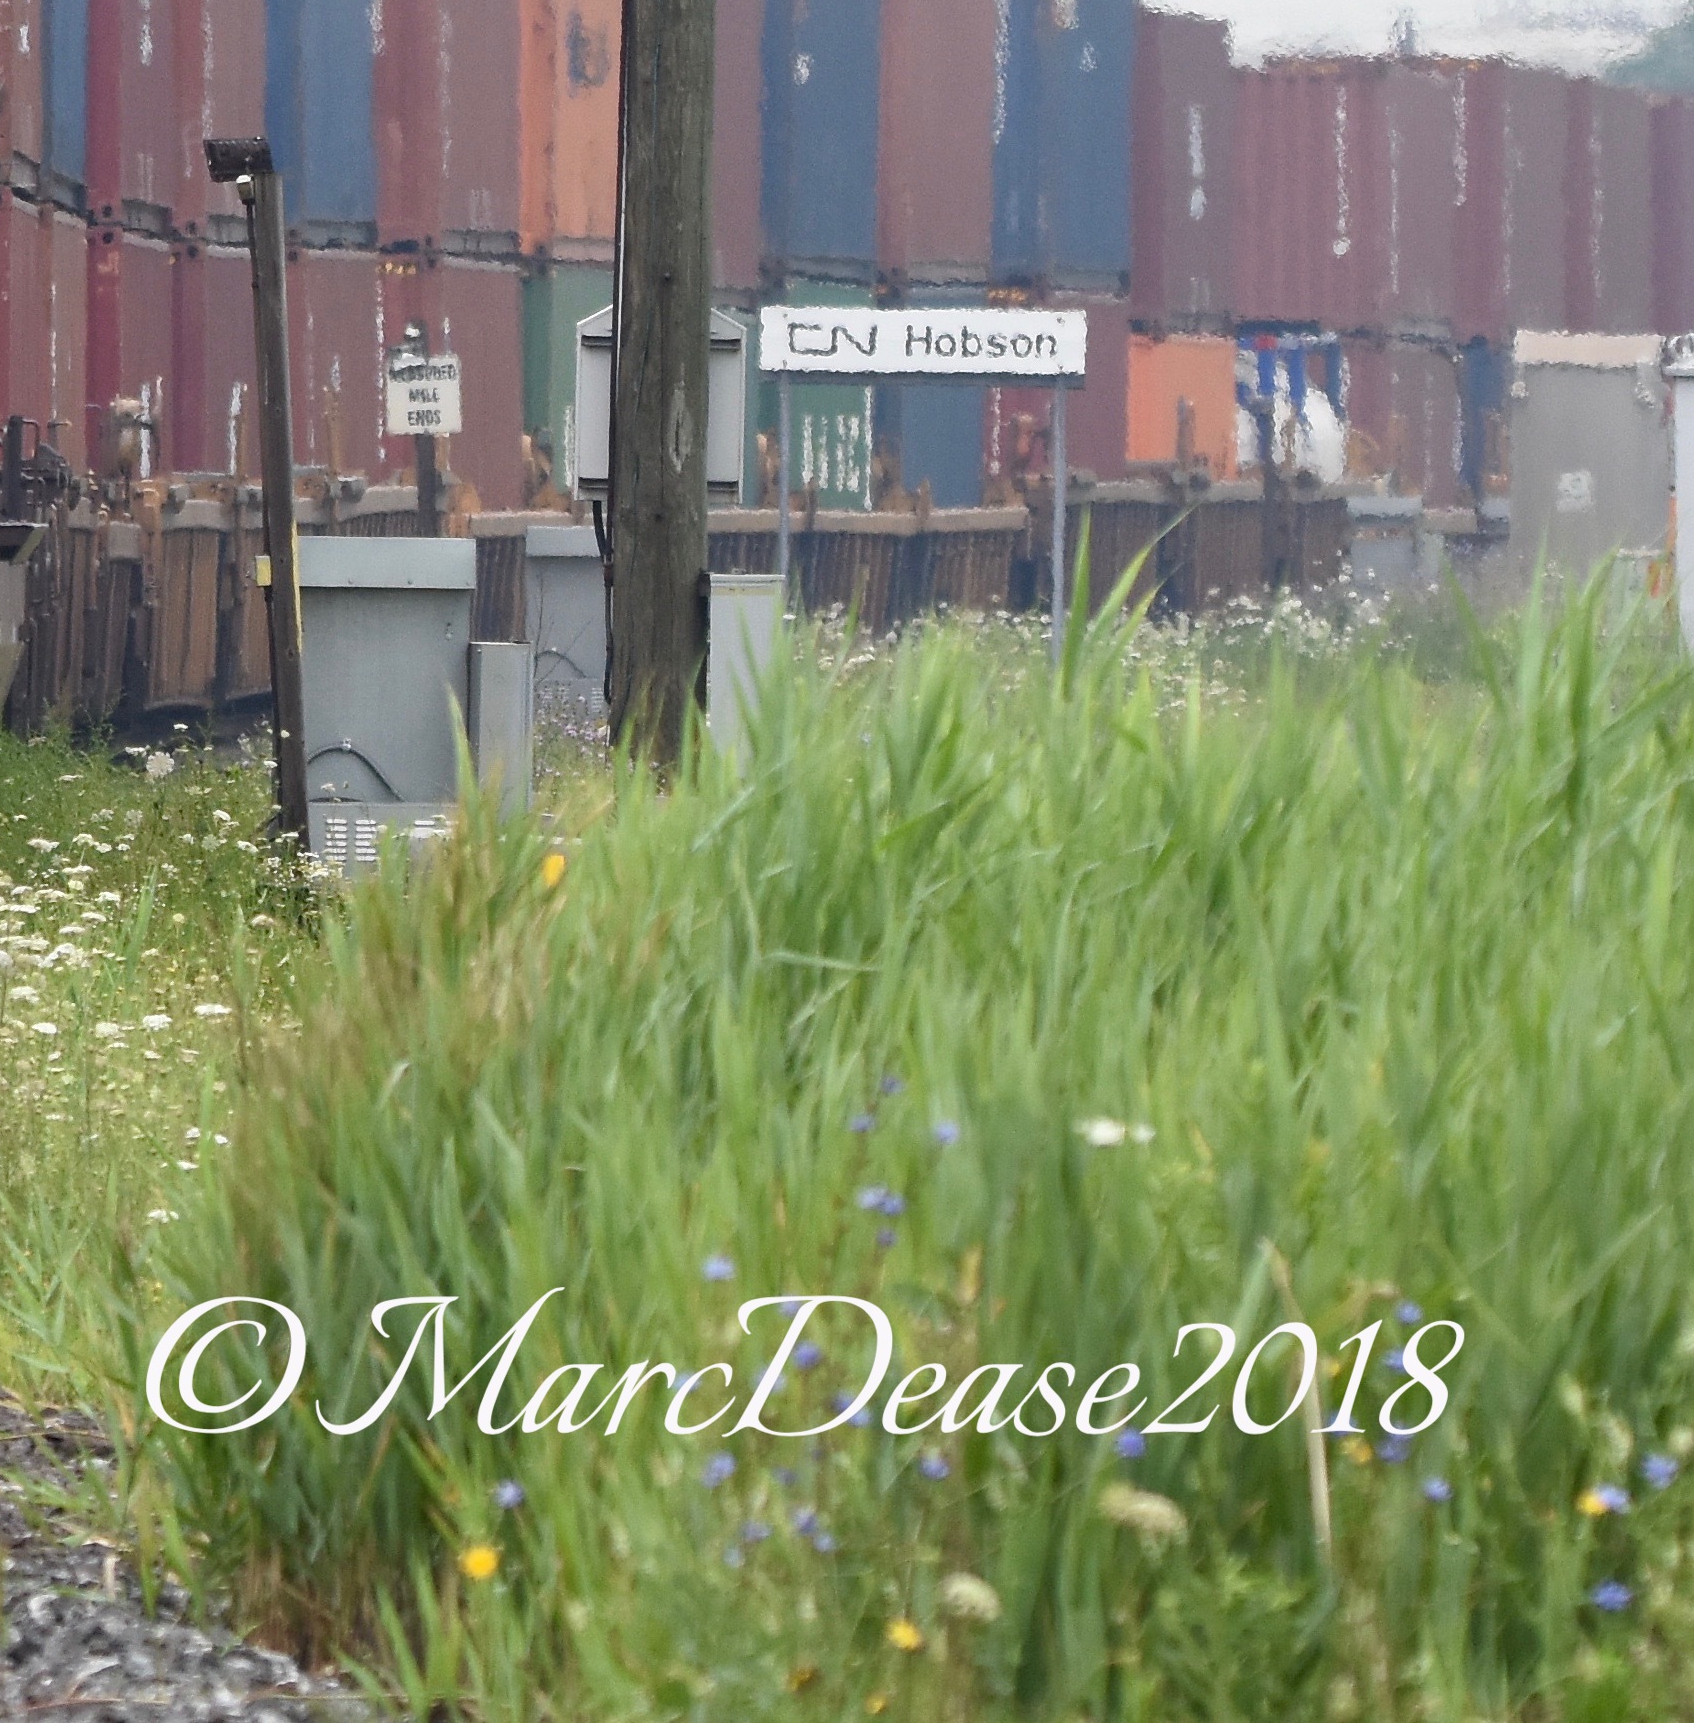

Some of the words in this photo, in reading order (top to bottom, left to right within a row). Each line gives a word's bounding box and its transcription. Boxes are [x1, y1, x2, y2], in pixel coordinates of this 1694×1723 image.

[787, 321, 878, 357] CN
[905, 324, 1057, 359] Hobson
[407, 409, 441, 426] ENDS
